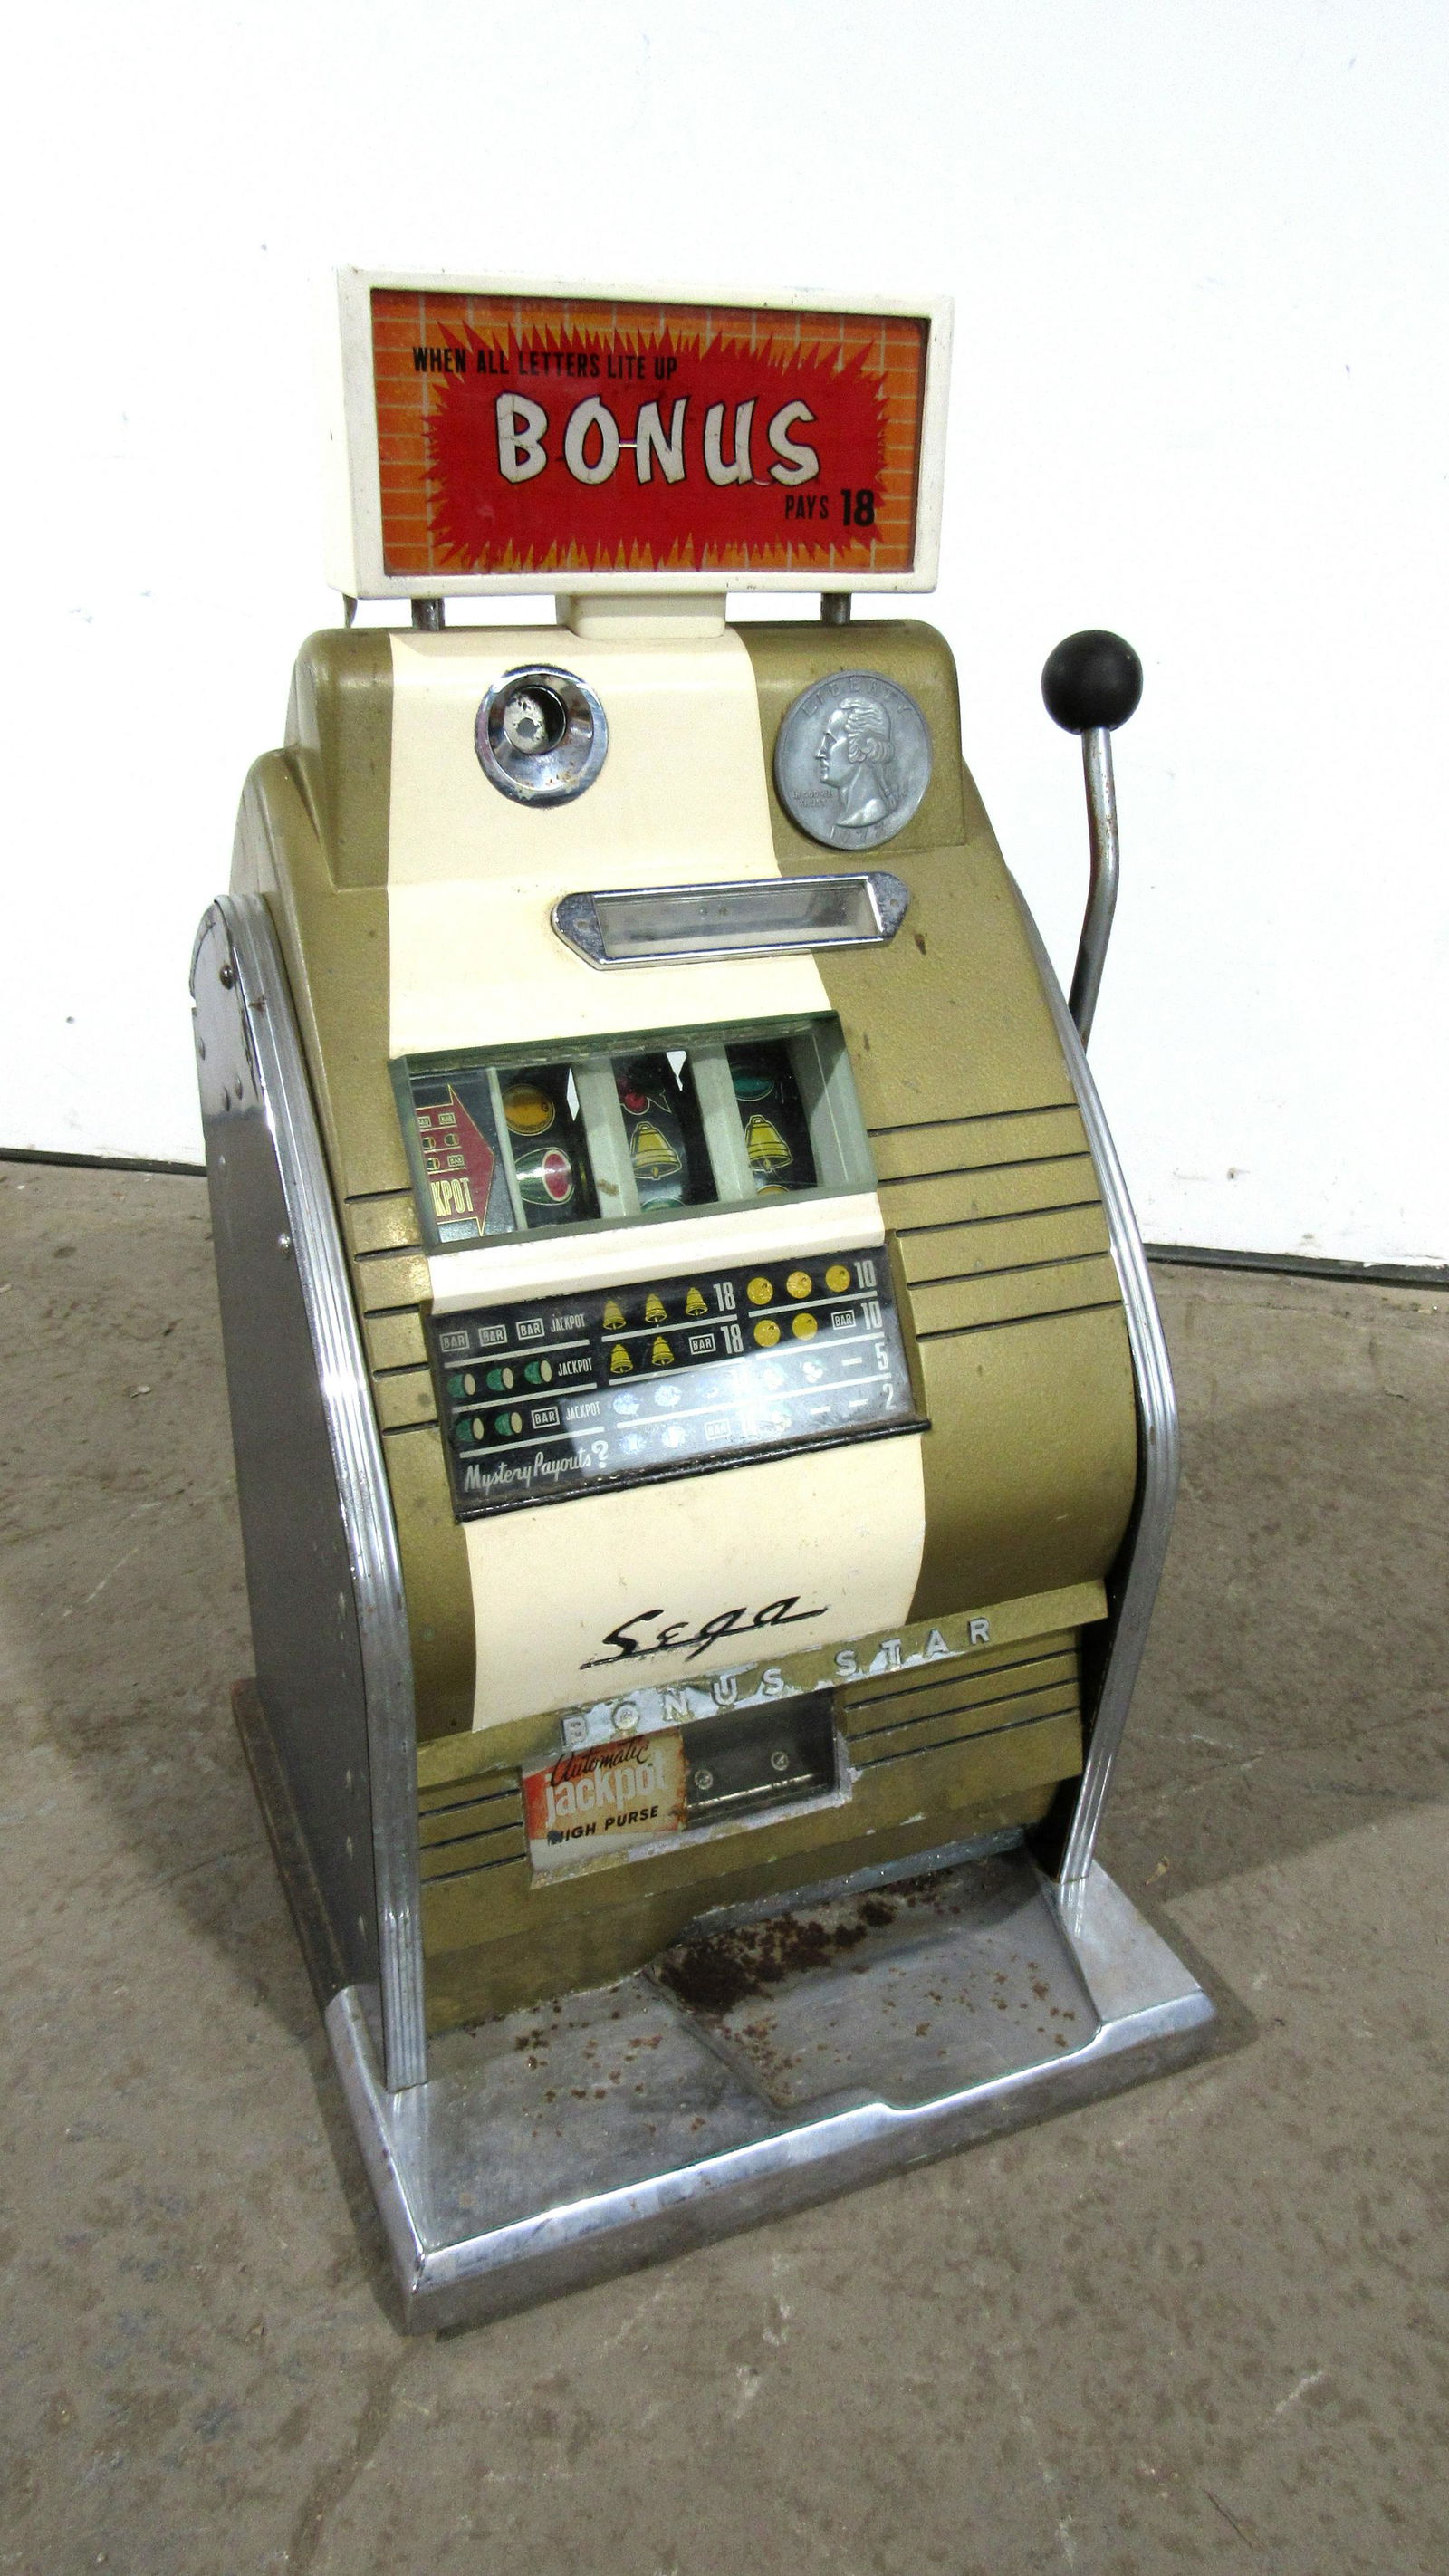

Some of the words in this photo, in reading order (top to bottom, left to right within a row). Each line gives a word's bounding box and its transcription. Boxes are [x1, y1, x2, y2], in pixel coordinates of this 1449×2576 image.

[412, 346, 467, 374] WHEN
[476, 349, 510, 375] ALL
[517, 351, 600, 379] LETTERS
[606, 352, 647, 380] LITE
[653, 355, 678, 382] UP
[494, 389, 820, 486] BONUS
[784, 493, 829, 521] PAYS
[840, 488, 876, 527] 18
[854, 1260, 877, 1290] 10
[713, 1282, 736, 1312] 18
[550, 1313, 586, 1334] JACKPOT
[860, 1301, 883, 1331] 10
[720, 1323, 744, 1354] 18
[557, 1357, 593, 1377] JACKPOT
[874, 1341, 889, 1370] 5
[565, 1400, 601, 1421] JACKPOT
[882, 1383, 897, 1410] 2
[464, 1463, 532, 1495] Mystery
[580, 1595, 829, 1670] Sega
[561, 1667, 785, 1747] BONUS
[834, 1617, 991, 1676] STAR
[550, 1735, 651, 1788] Automatic
[544, 1749, 669, 1829] jackpot
[604, 1805, 659, 1831] PURSE
